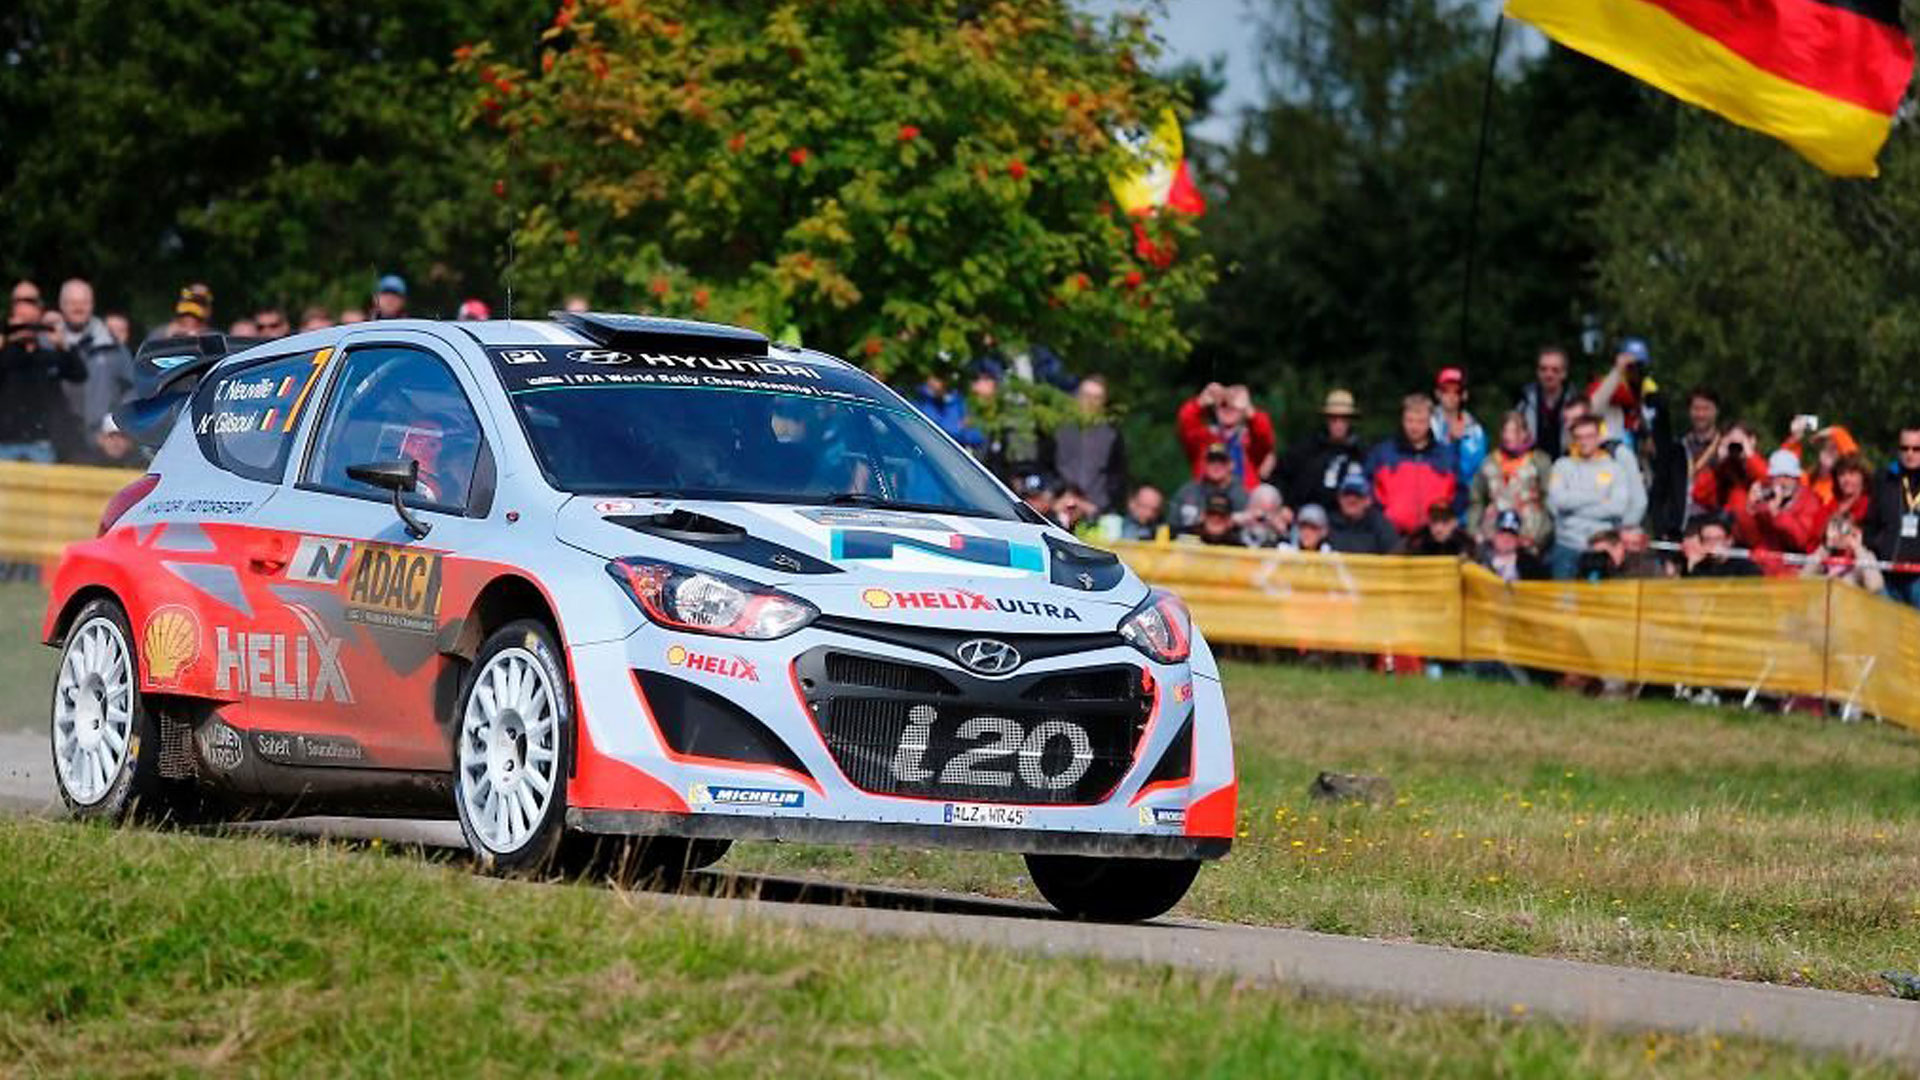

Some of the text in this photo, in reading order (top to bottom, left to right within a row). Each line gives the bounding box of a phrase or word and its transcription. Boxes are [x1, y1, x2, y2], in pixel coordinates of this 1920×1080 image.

[639, 353, 823, 380] HYUNDAI
[574, 374, 606, 383] FIA
[606, 374, 656, 383] World
[657, 374, 699, 386] Rally
[702, 375, 813, 396] Championship
[350, 548, 428, 611] ADAC
[894, 587, 1083, 623] HELIX ULTRA
[213, 602, 357, 704] HELIX
[685, 652, 760, 684] HELIX
[890, 703, 1095, 791] i20
[715, 789, 800, 804] MICHELIN
